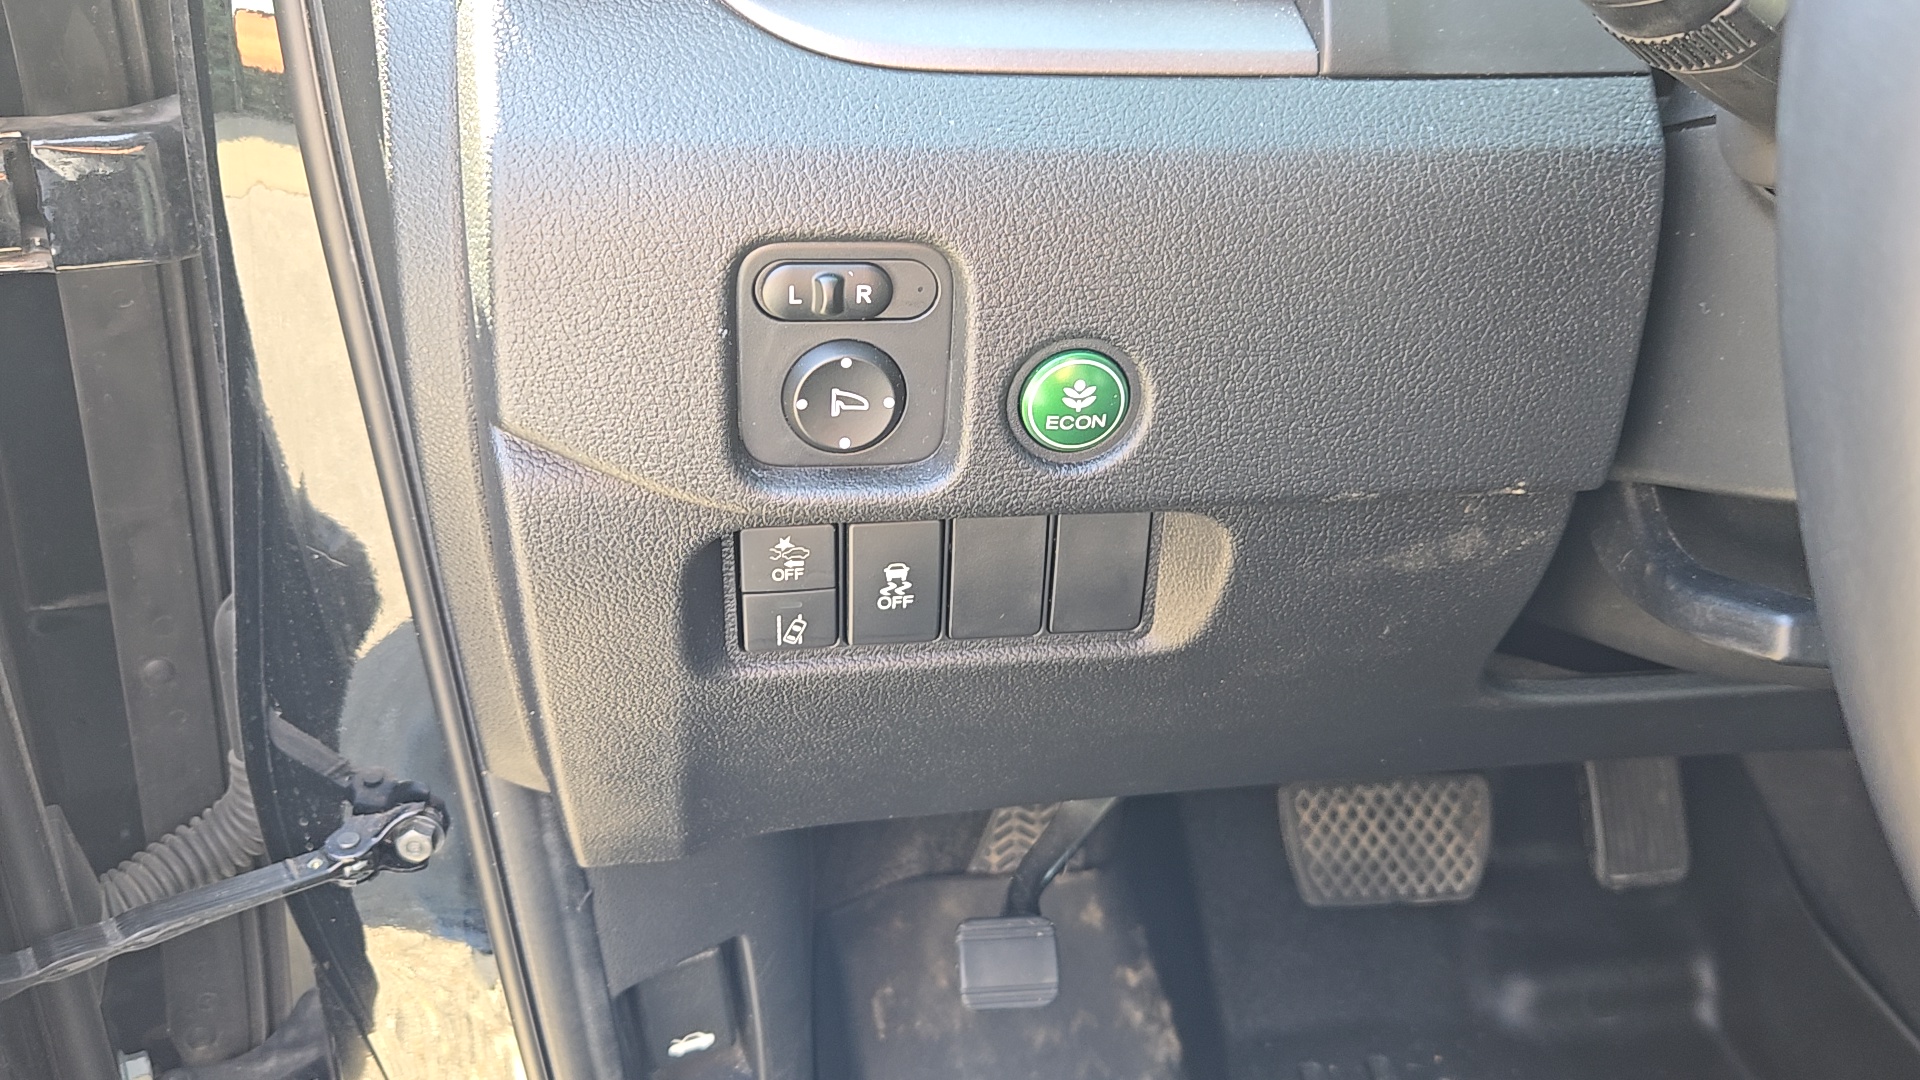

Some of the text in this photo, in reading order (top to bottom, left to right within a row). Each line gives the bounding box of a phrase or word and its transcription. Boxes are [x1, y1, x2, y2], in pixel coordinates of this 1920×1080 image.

[788, 284, 872, 304] L R
[1045, 413, 1107, 431] ECON
[771, 567, 805, 581] OFF
[876, 594, 915, 610] OFF
